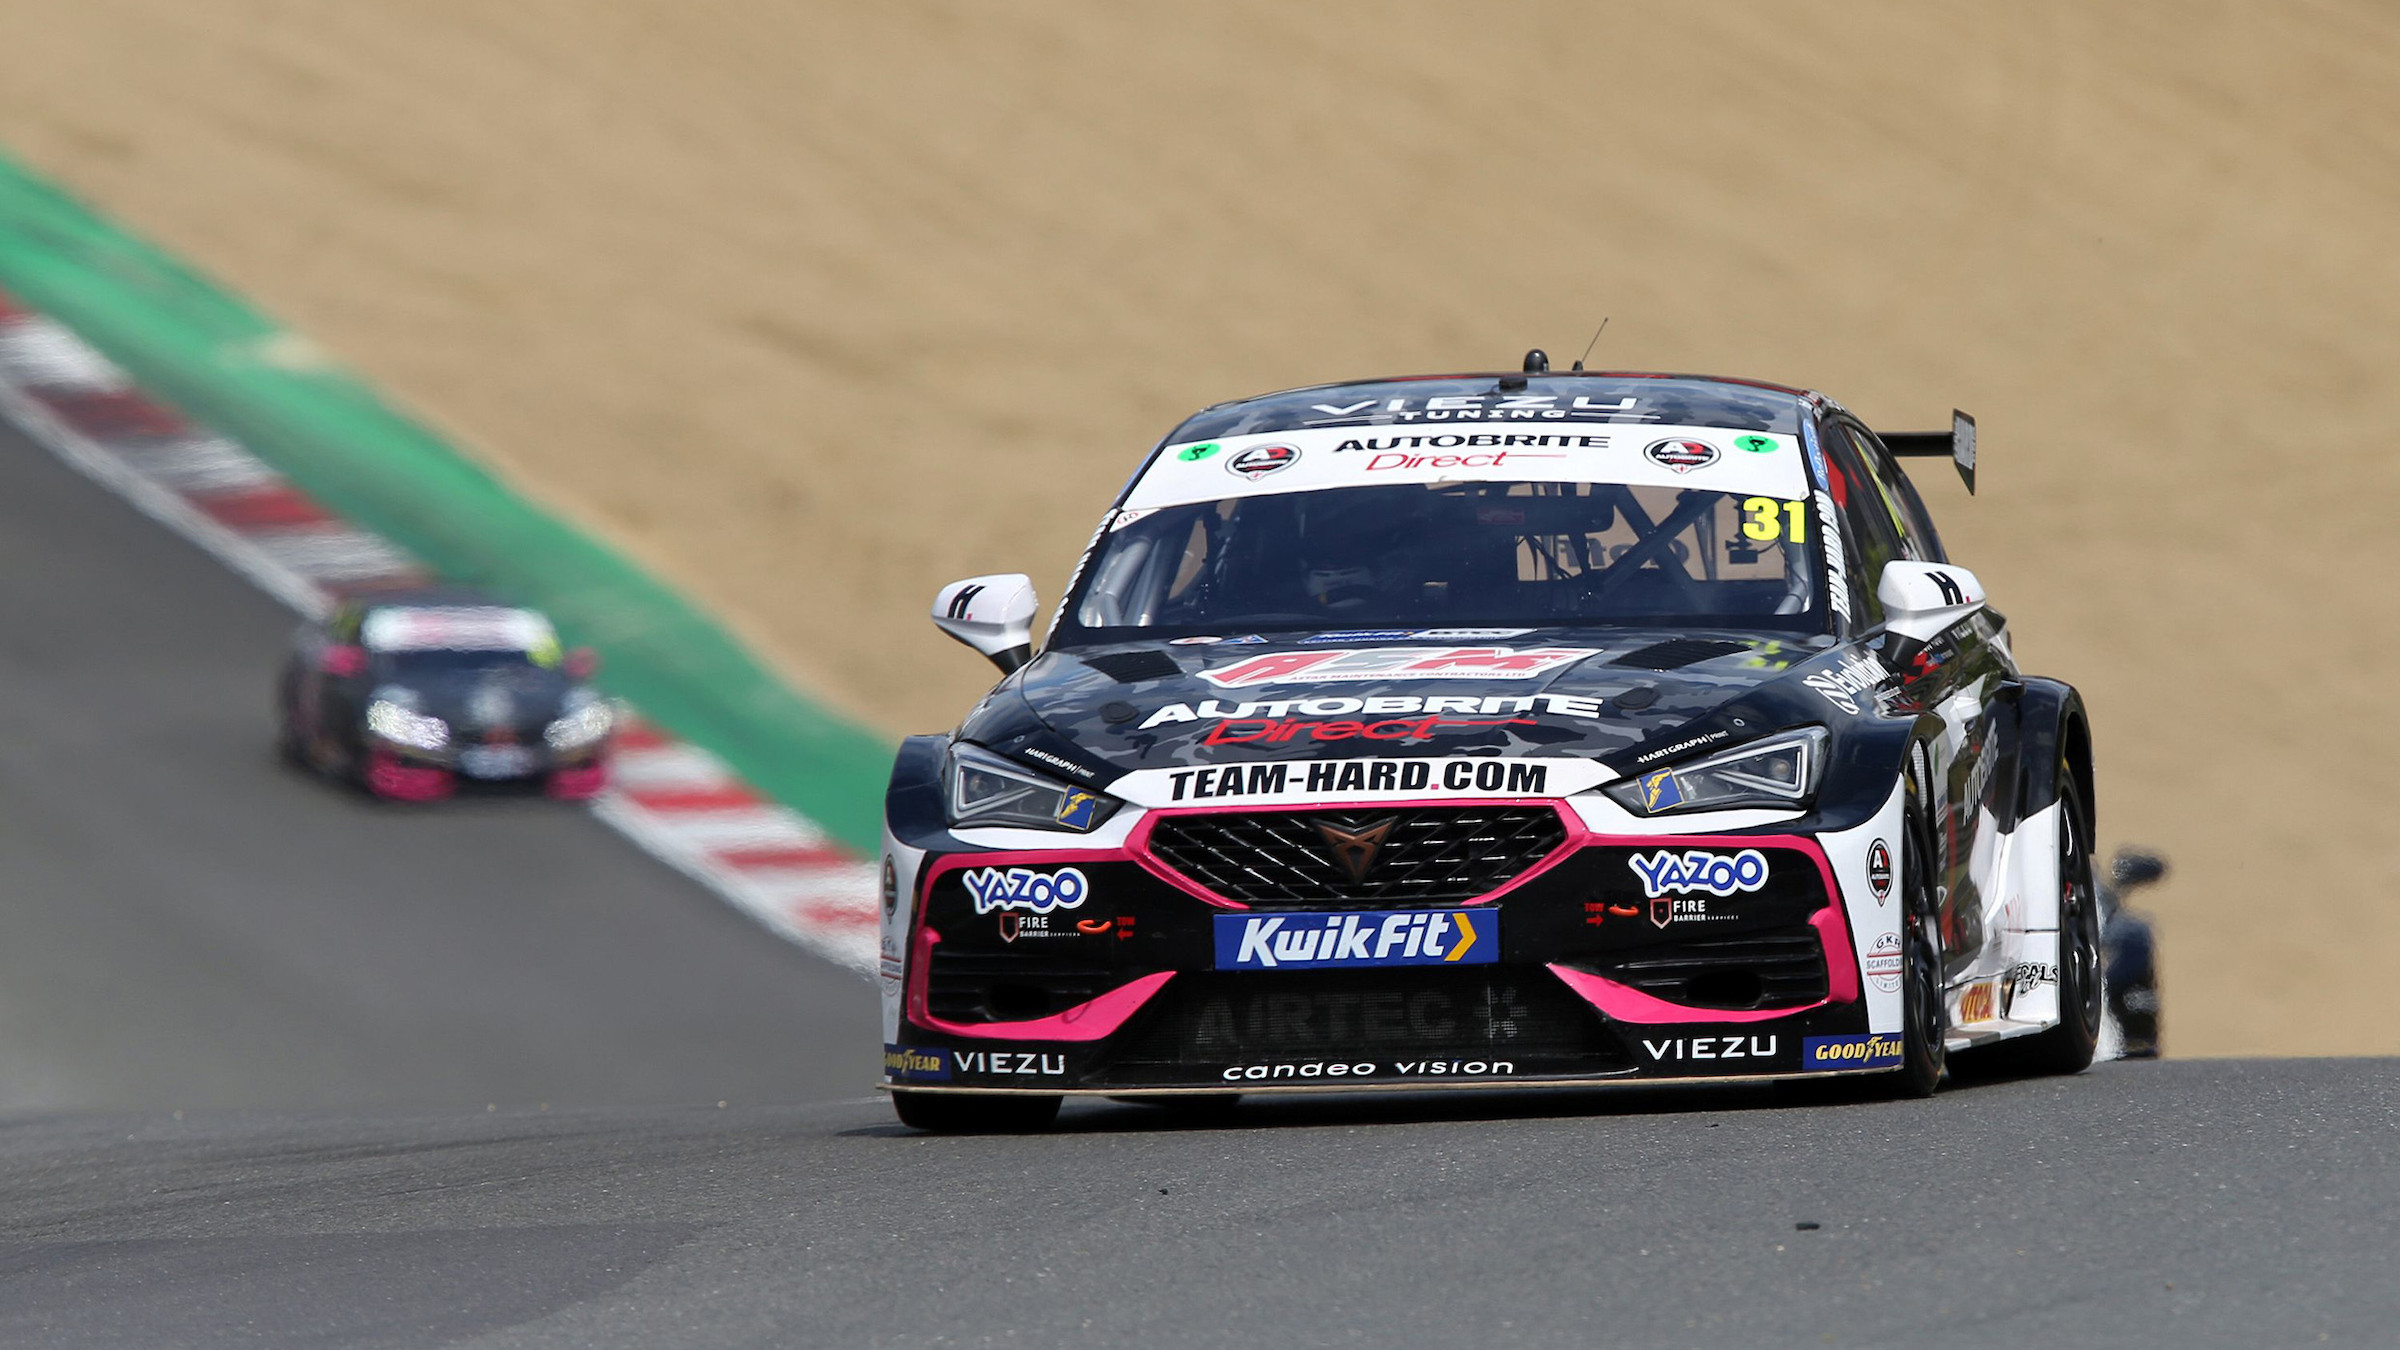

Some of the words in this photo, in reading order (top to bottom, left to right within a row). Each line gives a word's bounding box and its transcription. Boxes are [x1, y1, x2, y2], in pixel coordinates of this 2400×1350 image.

[1312, 396, 1639, 415] VIEZU
[1401, 410, 1566, 421] TUNING
[1334, 434, 1612, 452] AUTOBRITE
[1365, 450, 1567, 471] Direct
[1742, 498, 1806, 543] 31
[1138, 693, 1604, 730] AUTOBRITE
[1203, 713, 1537, 746] Direct
[1169, 760, 1548, 801] TEAM-HARD.COM
[1628, 849, 1769, 897] YAZOO
[962, 866, 1089, 915] YAZOO
[1673, 900, 1706, 912] FIRE
[1019, 916, 1049, 929] FIRE
[1673, 914, 1706, 922] BARRIER
[1641, 1034, 1777, 1060] VIEZU
[953, 1051, 1066, 1075] VIEZU
[1222, 1061, 1377, 1081] candeo
[1395, 1060, 1515, 1075] vision
